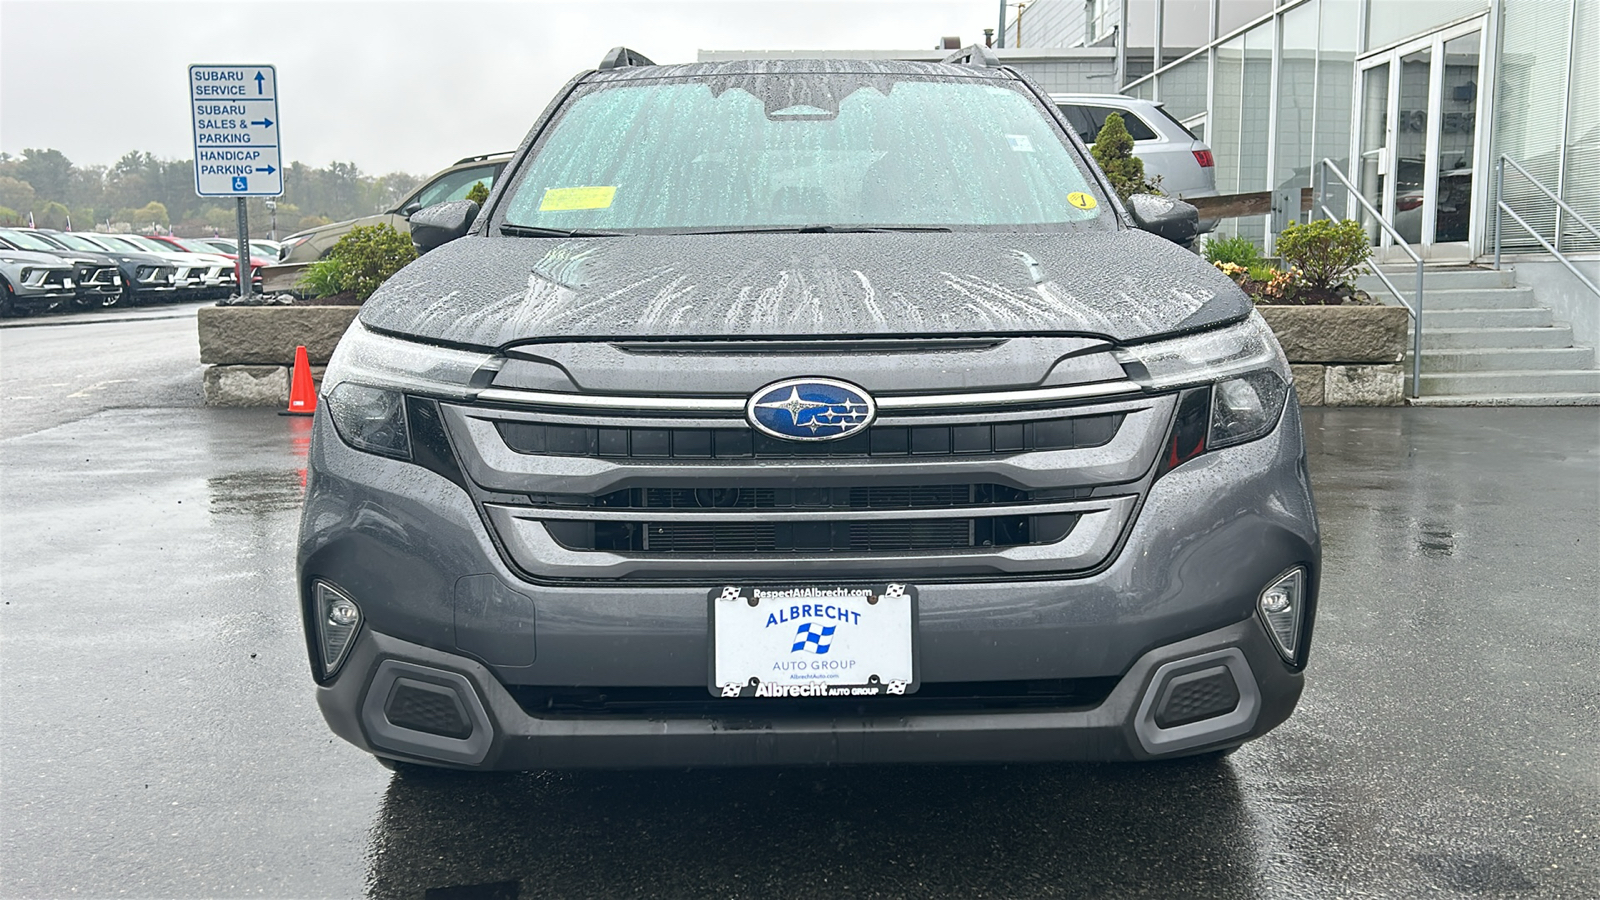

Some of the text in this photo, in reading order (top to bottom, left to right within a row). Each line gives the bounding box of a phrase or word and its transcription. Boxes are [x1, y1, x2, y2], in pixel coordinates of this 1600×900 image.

[195, 71, 244, 81] SUBARU
[196, 85, 246, 95] SERVICE
[197, 105, 246, 115] SUBARU
[198, 119, 248, 129] SALES &
[199, 133, 251, 143] PARKING
[200, 151, 260, 160] HANDICAP
[201, 165, 253, 175] PARKING
[753, 587, 873, 599] RespectAtAlbrecht.com
[765, 603, 861, 628] ALBRECHT
[772, 660, 856, 671] AUTO GROUP
[755, 681, 879, 697] Albrecht AUTO GROUP
